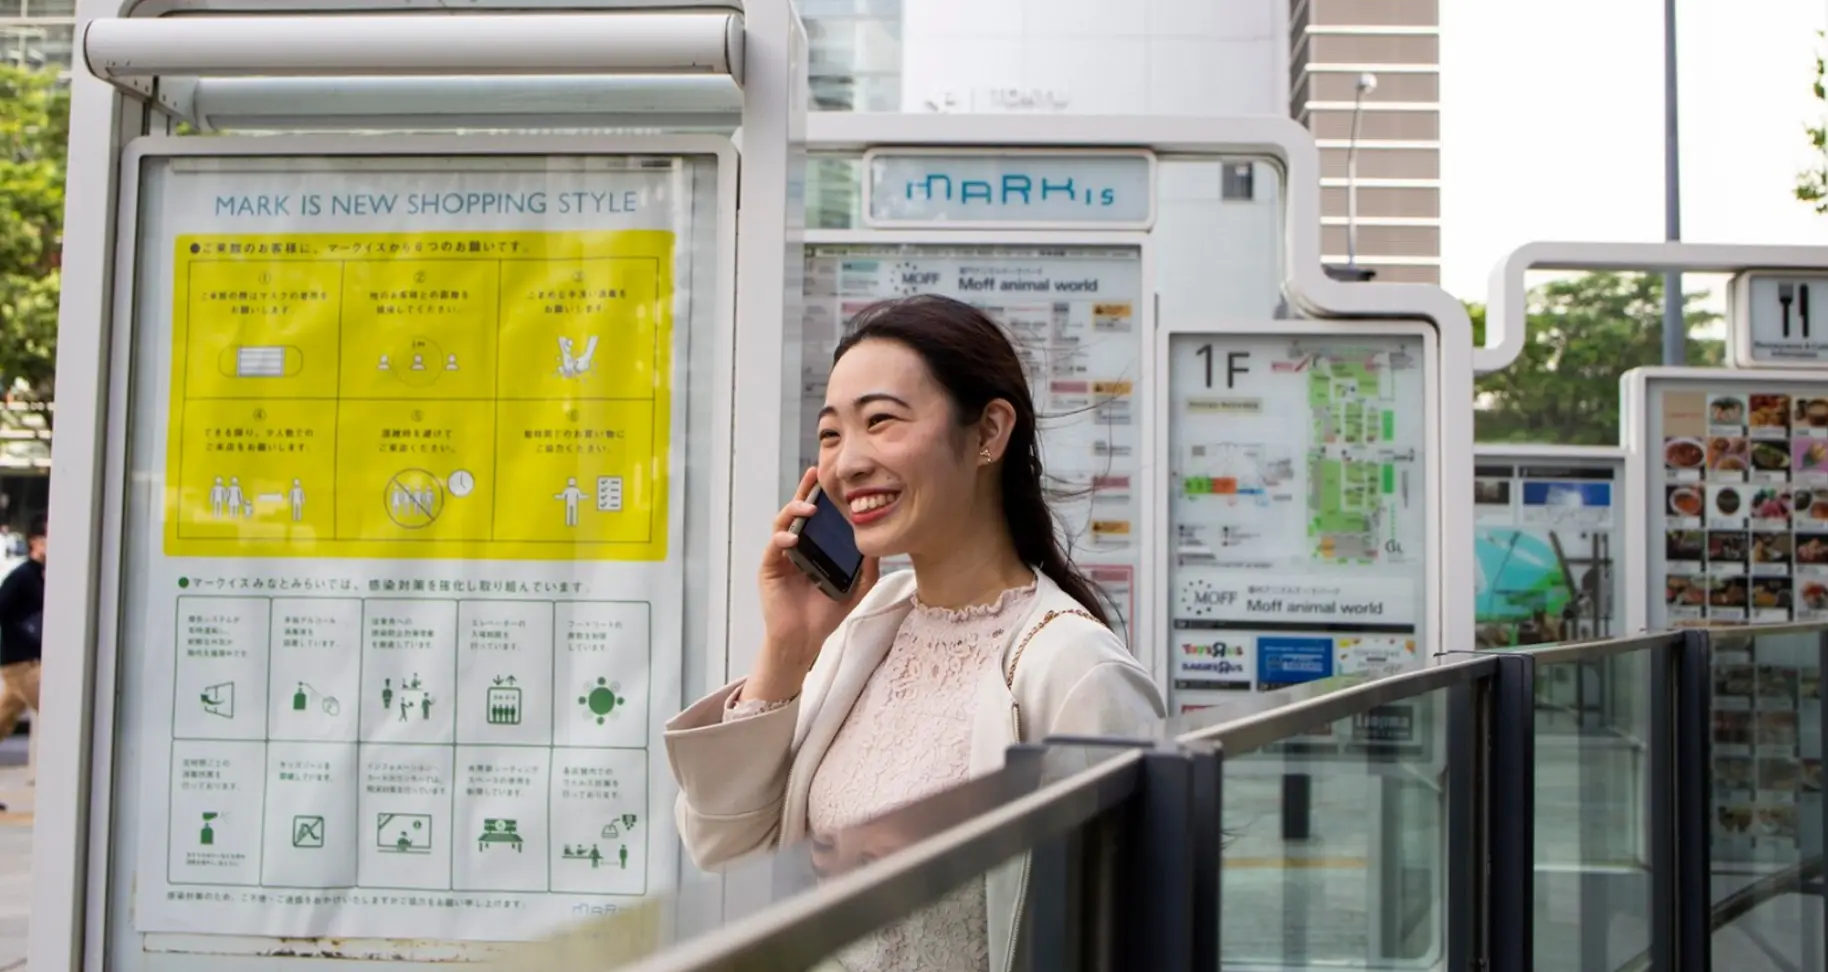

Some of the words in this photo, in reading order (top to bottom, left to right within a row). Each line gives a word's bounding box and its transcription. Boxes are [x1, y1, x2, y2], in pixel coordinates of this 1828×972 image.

[215, 195, 290, 217] MARK
[300, 194, 321, 217] IS
[331, 193, 398, 216] NEW
[406, 192, 547, 215] SHOPPING
[558, 191, 638, 214] STYLE
[958, 277, 996, 291] Moff
[999, 279, 1051, 291] animal
[1054, 279, 1099, 292] world
[1196, 344, 1251, 389] 1F
[1247, 600, 1282, 613] Moff
[1287, 602, 1336, 615] animal
[1341, 602, 1384, 616] world
